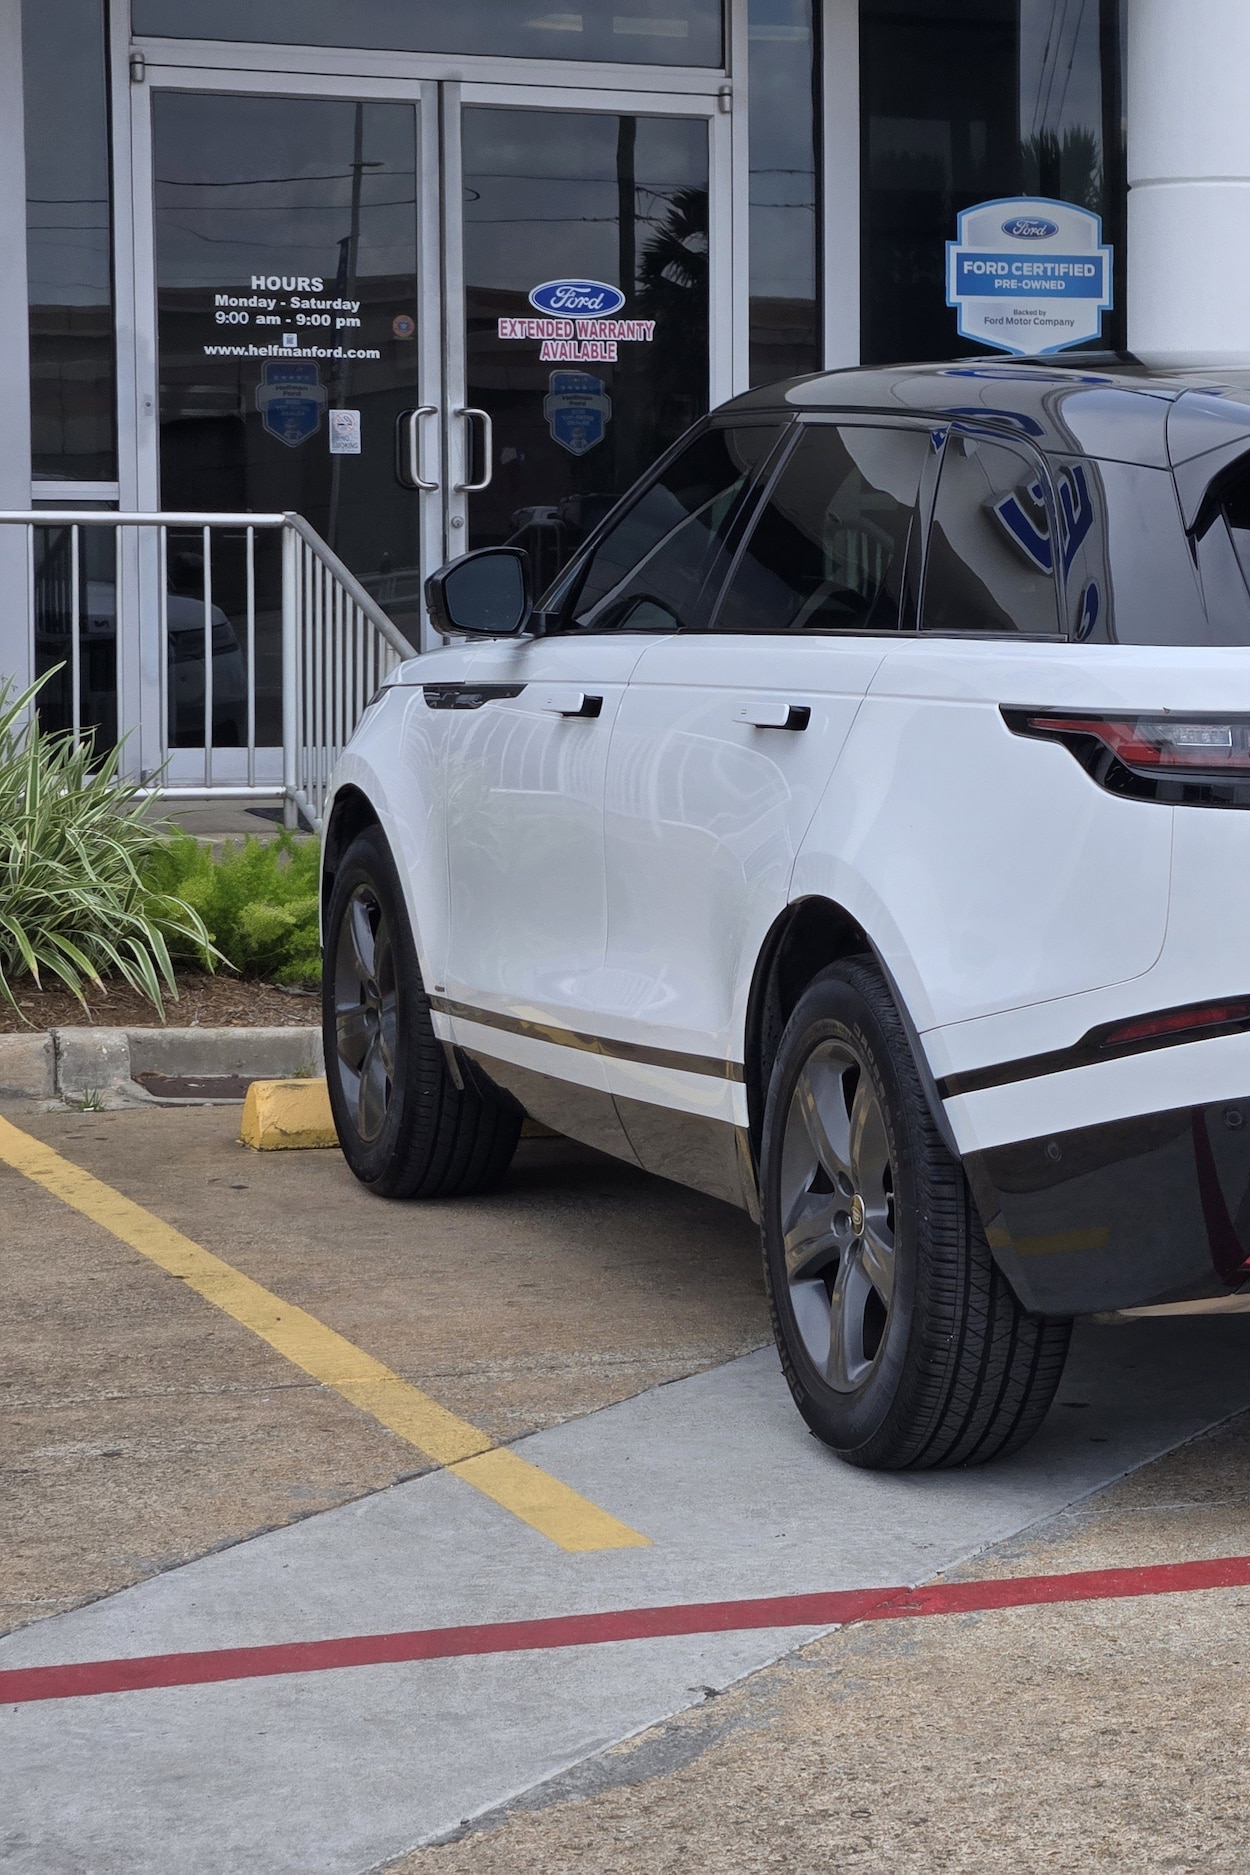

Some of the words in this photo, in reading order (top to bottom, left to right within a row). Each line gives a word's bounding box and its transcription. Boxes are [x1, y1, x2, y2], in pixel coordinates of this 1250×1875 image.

[1012, 219, 1048, 236] Ford
[963, 261, 1008, 275] FORD
[1011, 262, 1096, 277] CERTIFIED
[251, 275, 324, 292] HOURS
[994, 279, 1066, 290] PRE-OWNED
[215, 294, 277, 310] Monday
[290, 297, 360, 313] Saturday
[550, 285, 604, 310] Ford
[215, 311, 250, 324] 9:00
[255, 315, 281, 325] am
[296, 314, 331, 326] 9:00
[335, 317, 361, 329] pm
[1038, 309, 1047, 317] by
[499, 319, 573, 338] EXTENDED
[577, 320, 655, 341] WARRANTY
[984, 317, 1004, 325] Ford
[1005, 317, 1032, 326] Motor
[1033, 318, 1075, 327] Company
[203, 344, 381, 359] www.helfmanford.com
[541, 342, 616, 360] AVAILABLE
